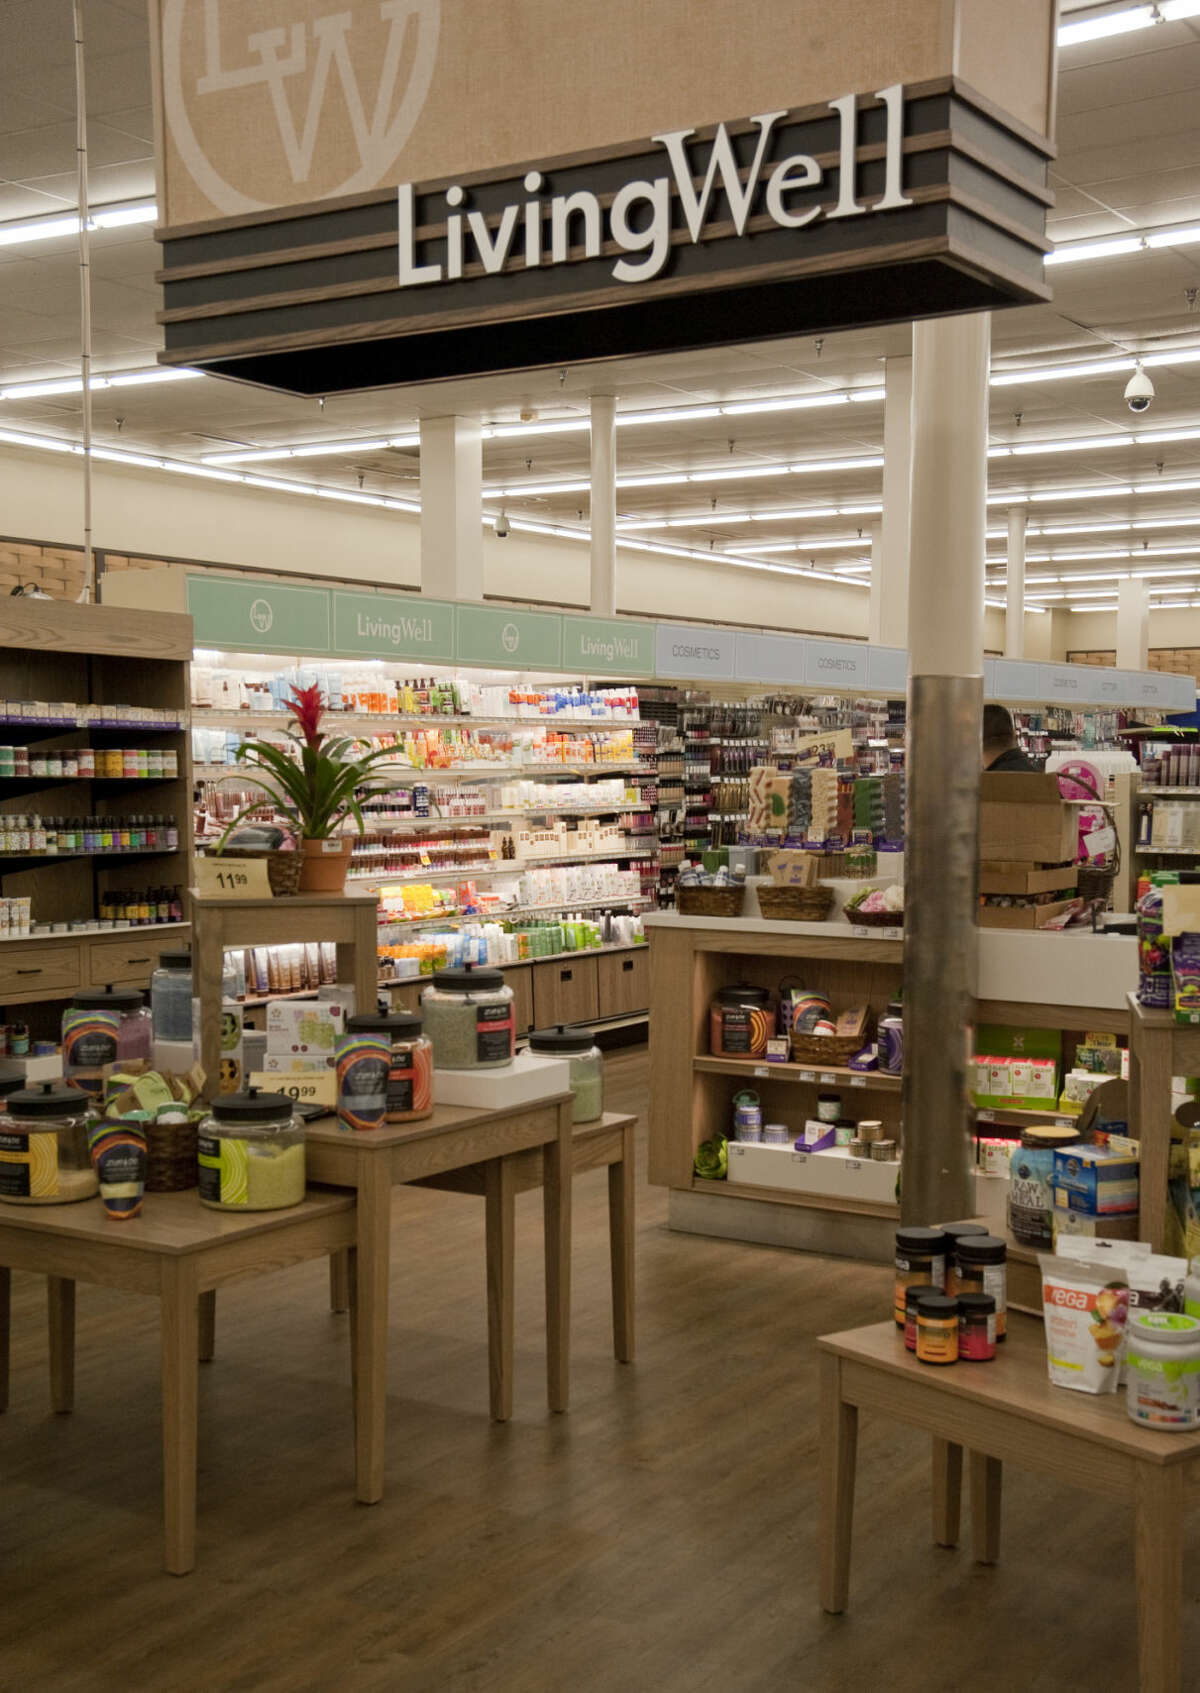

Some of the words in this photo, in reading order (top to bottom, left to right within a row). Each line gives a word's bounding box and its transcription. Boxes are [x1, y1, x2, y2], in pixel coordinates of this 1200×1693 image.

[396, 84, 915, 288] LivingWell
[357, 612, 433, 645] LivingWell
[580, 634, 640, 661] LivingWell
[672, 644, 720, 661] COSMETICS
[817, 657, 857, 672] COSMETICS
